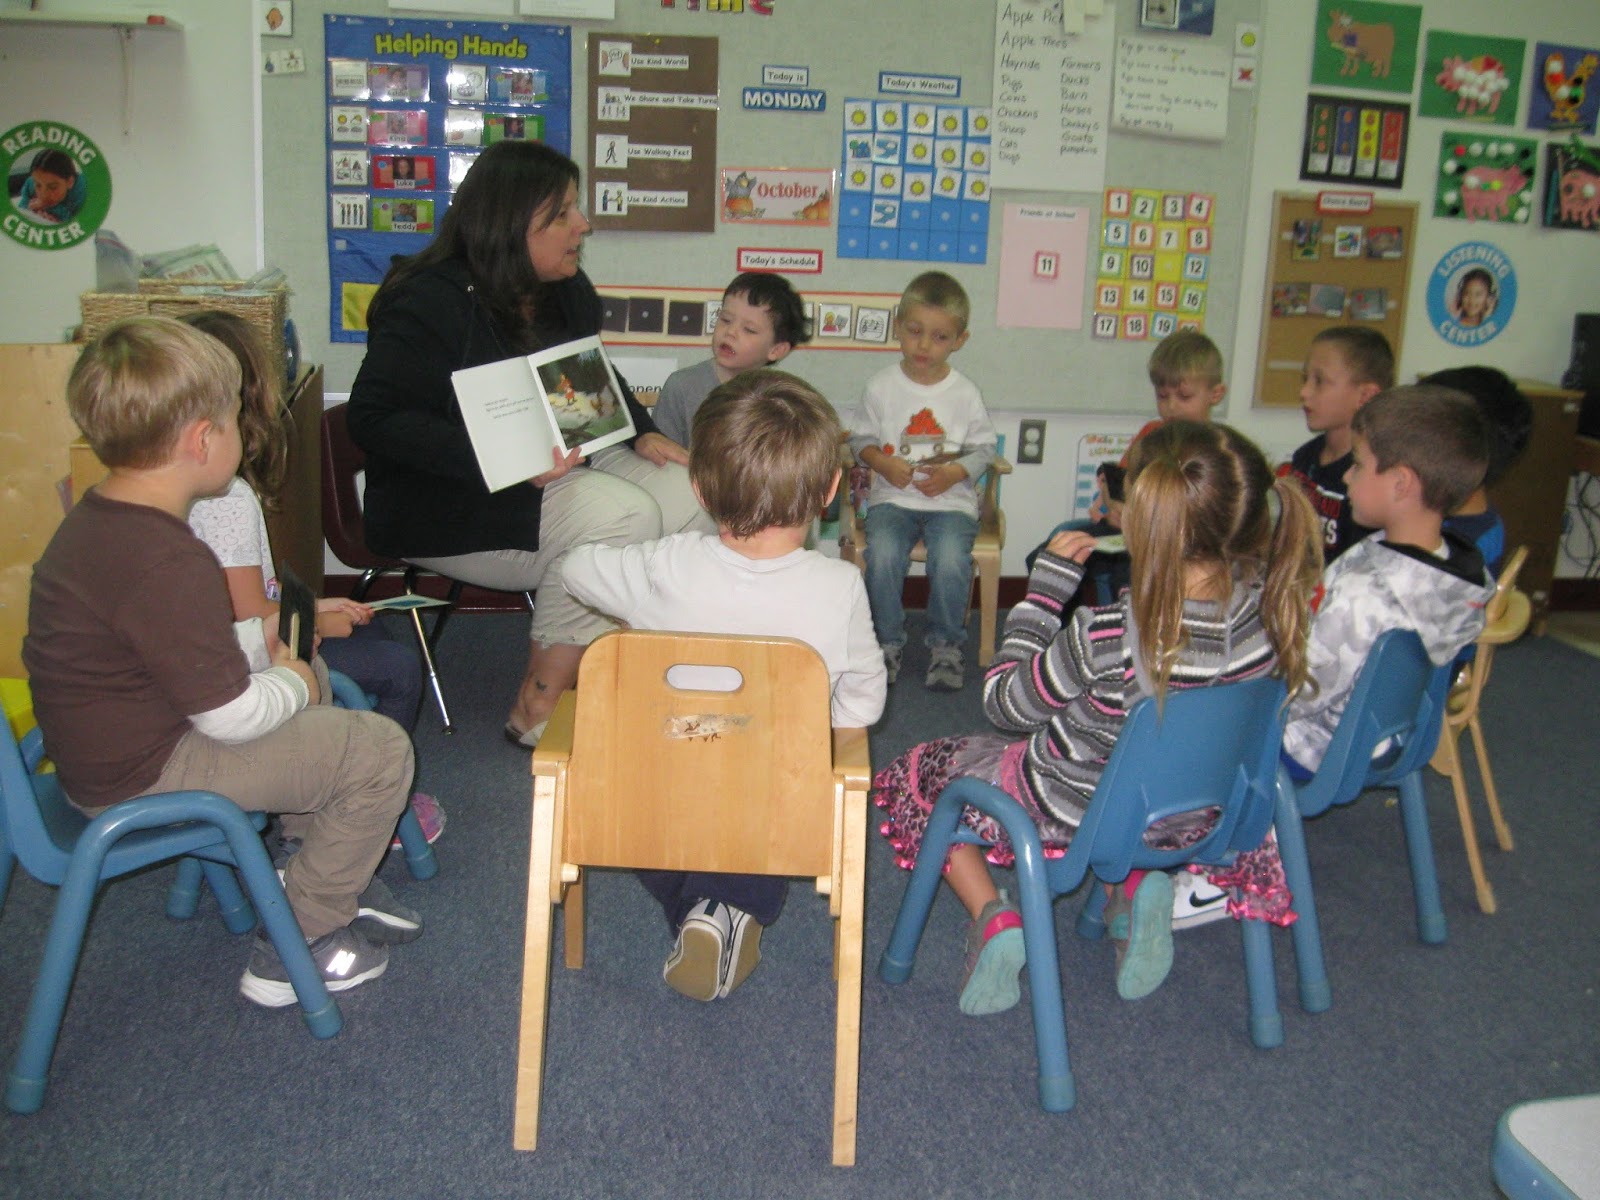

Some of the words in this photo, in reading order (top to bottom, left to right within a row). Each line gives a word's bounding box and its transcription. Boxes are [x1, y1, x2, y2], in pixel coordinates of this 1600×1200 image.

[1002, 3, 1034, 27] Apple
[375, 32, 458, 60] Helping
[463, 34, 528, 59] Hands
[1001, 31, 1034, 50] Apple
[768, 71, 794, 83] Today
[796, 73, 804, 81] is
[886, 77, 916, 89] Today's
[920, 80, 956, 90] Weather
[745, 91, 824, 110] MONDAY
[1061, 87, 1088, 100] Barn
[2, 126, 96, 165] READING
[758, 182, 818, 198] October
[1116, 195, 1122, 210] 1
[1139, 200, 1148, 215] 2
[1170, 199, 1178, 214] 3
[1195, 200, 1204, 215] 4
[3, 214, 85, 246] CENTER
[1113, 225, 1121, 239] 5
[1139, 228, 1147, 242] 6
[1165, 231, 1173, 247] 7
[1194, 231, 1203, 245] 8
[744, 255, 776, 266] Today's
[780, 256, 816, 265] Schedule
[1041, 257, 1053, 273] 11
[1106, 255, 1115, 270] 9
[1135, 259, 1149, 273] 10
[1190, 260, 1203, 273] 12
[1103, 289, 1117, 304] 13
[1132, 288, 1145, 302] 14
[1161, 288, 1174, 303] 15
[1186, 292, 1199, 307] 16
[1100, 319, 1113, 332] 17
[1129, 319, 1142, 333] 18
[1158, 320, 1171, 333] 19
[1441, 320, 1497, 344] CENTER
